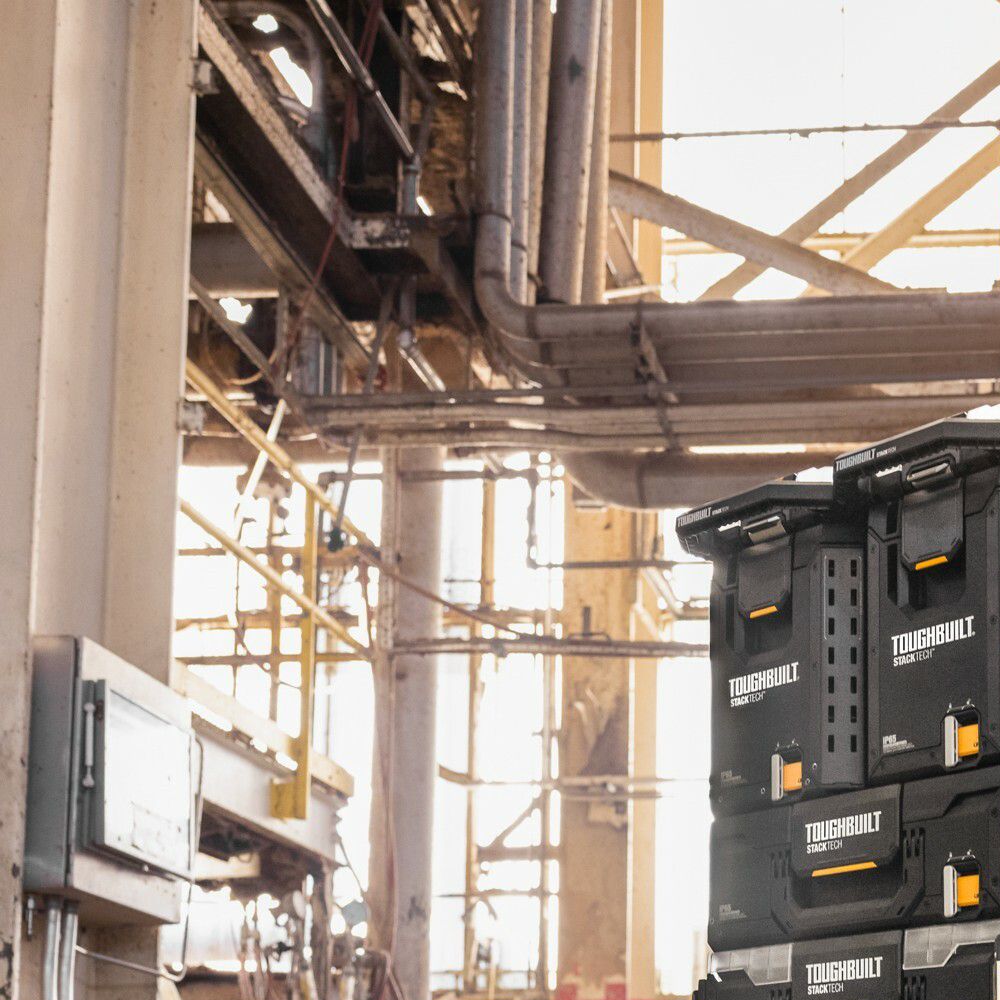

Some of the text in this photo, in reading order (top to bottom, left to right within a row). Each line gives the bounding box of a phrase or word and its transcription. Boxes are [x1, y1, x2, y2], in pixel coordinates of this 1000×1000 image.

[835, 449, 876, 472] TOUGHBUILT
[677, 507, 712, 527] TOUGHBUILT
[891, 615, 975, 656] TOUGHBUILT
[893, 648, 933, 667] STACKTECH
[728, 662, 799, 698] TOUGHBUILT
[730, 691, 765, 708] STACKTECH
[805, 811, 882, 843] TOUGHBUILT
[806, 839, 843, 854] STACKTECH
[806, 956, 883, 984] TOUGHBUILT
[807, 982, 844, 995] STACKTECH
